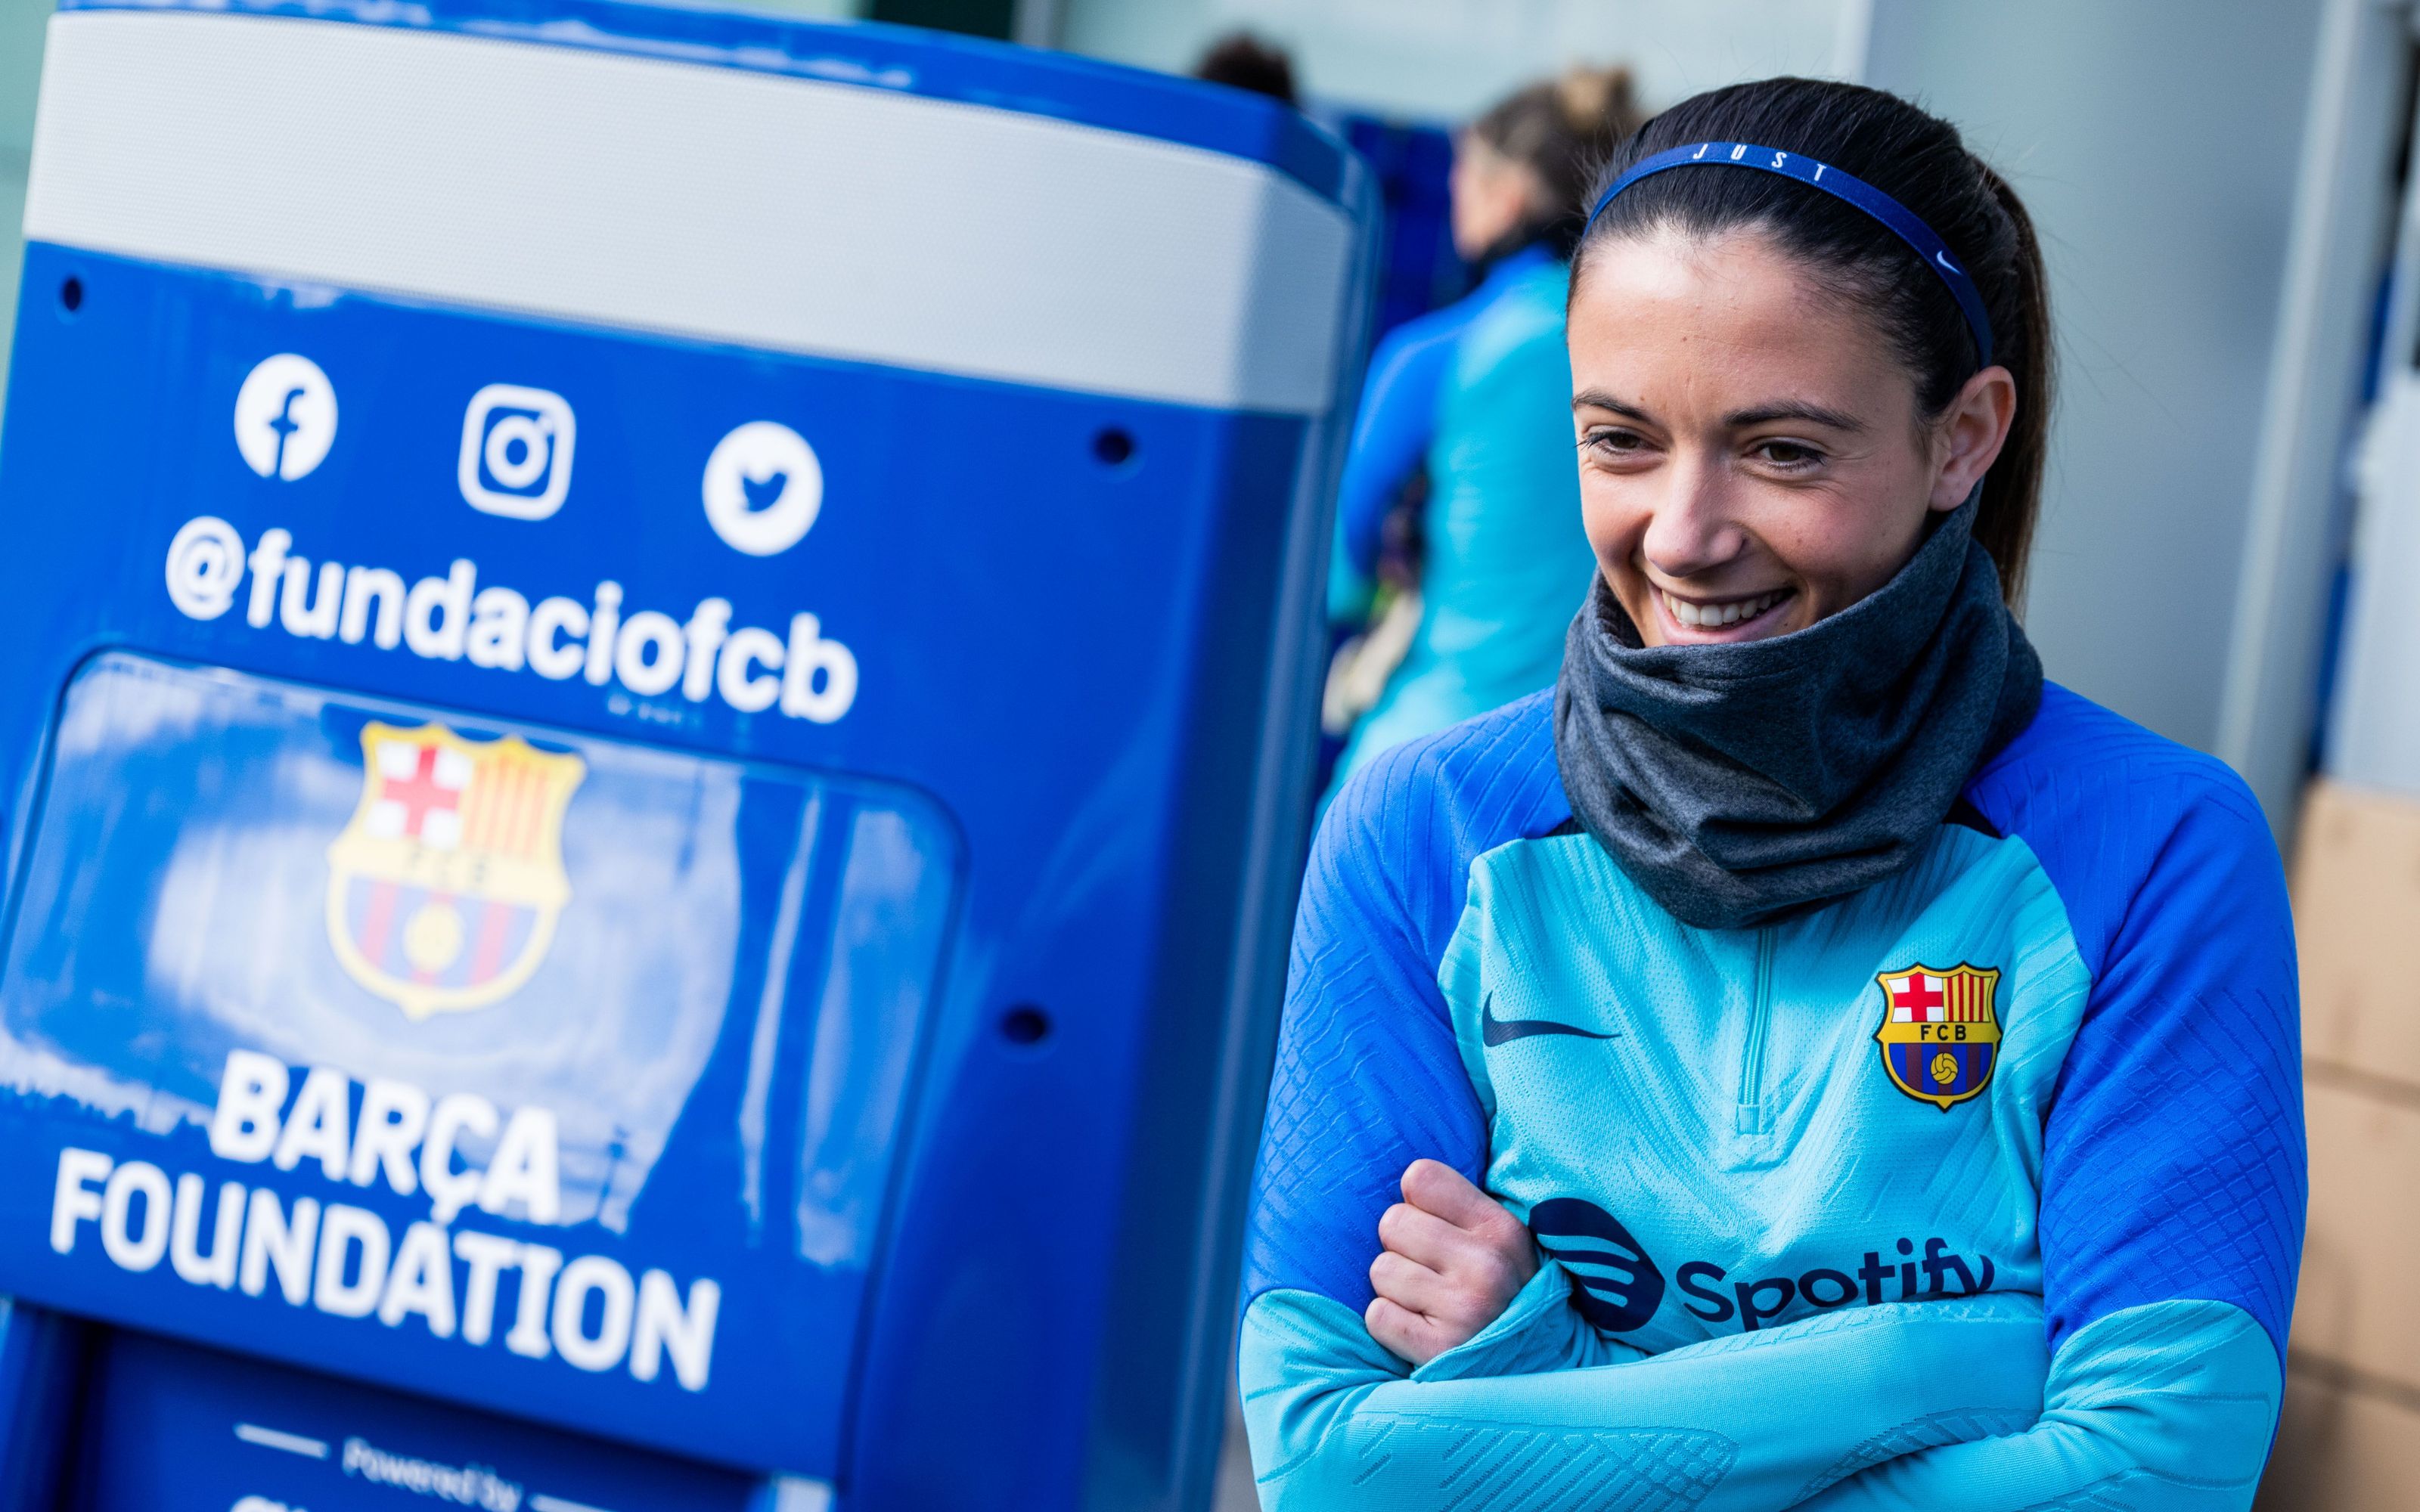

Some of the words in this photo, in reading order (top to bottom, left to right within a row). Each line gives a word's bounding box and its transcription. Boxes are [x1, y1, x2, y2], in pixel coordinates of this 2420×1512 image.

[1693, 144, 1827, 181] JUST
[164, 516, 858, 723] @fundaciofcb
[1920, 1024, 1966, 1041] FCB
[209, 1049, 561, 1226] BARÇA
[50, 1146, 721, 1392] FOUNDATION
[1676, 1237, 1995, 1331] Spotify
